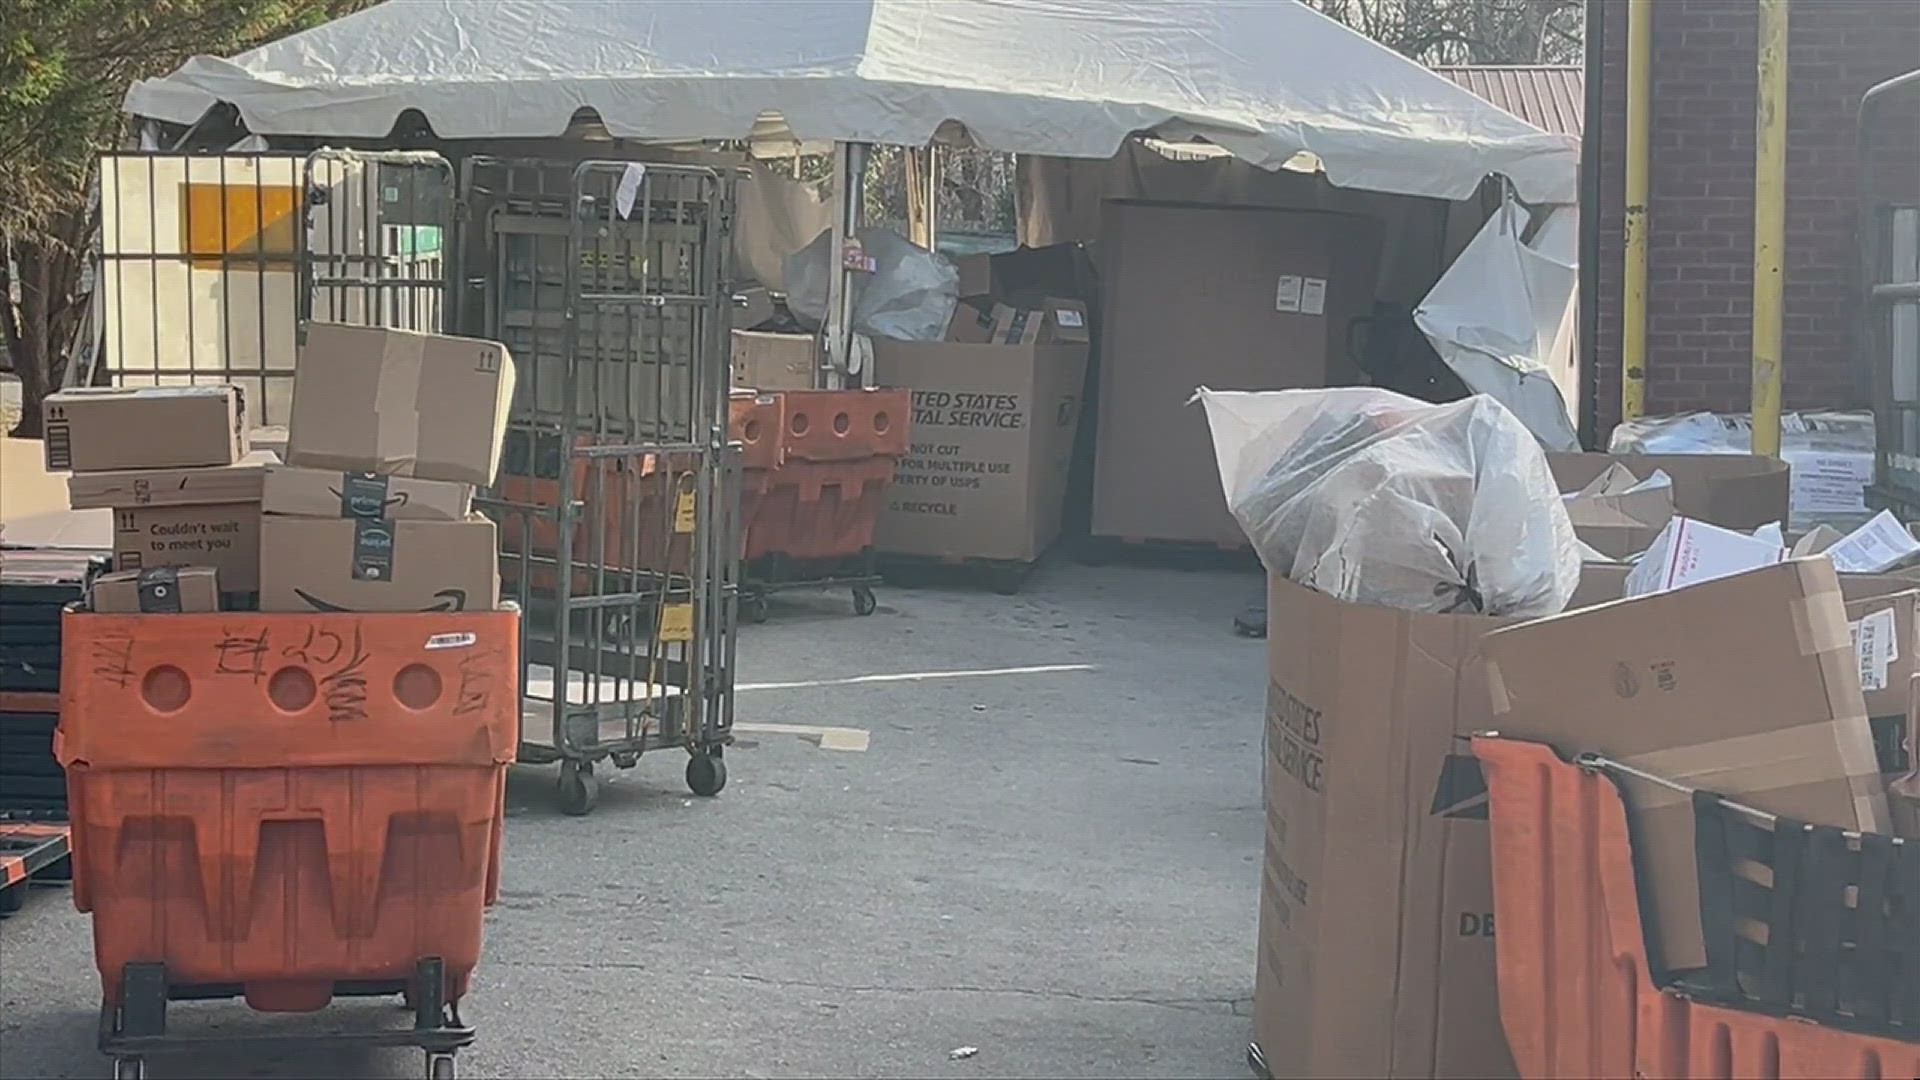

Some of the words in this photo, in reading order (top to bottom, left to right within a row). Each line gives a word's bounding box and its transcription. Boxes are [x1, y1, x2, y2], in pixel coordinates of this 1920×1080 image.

[953, 393, 1018, 410] STATES
[946, 411, 1023, 429] SERVICE
[937, 445, 960, 456] CUT
[901, 458, 924, 470] FOR
[927, 460, 985, 473] MULTIPLE
[987, 463, 1011, 474] USE
[932, 475, 948, 487] OF
[902, 502, 957, 515] RECYCLE
[150, 522, 206, 536] Couldn't
[210, 520, 239, 533] wait
[151, 540, 165, 551] to
[169, 539, 203, 550] meet
[206, 539, 231, 552] you
